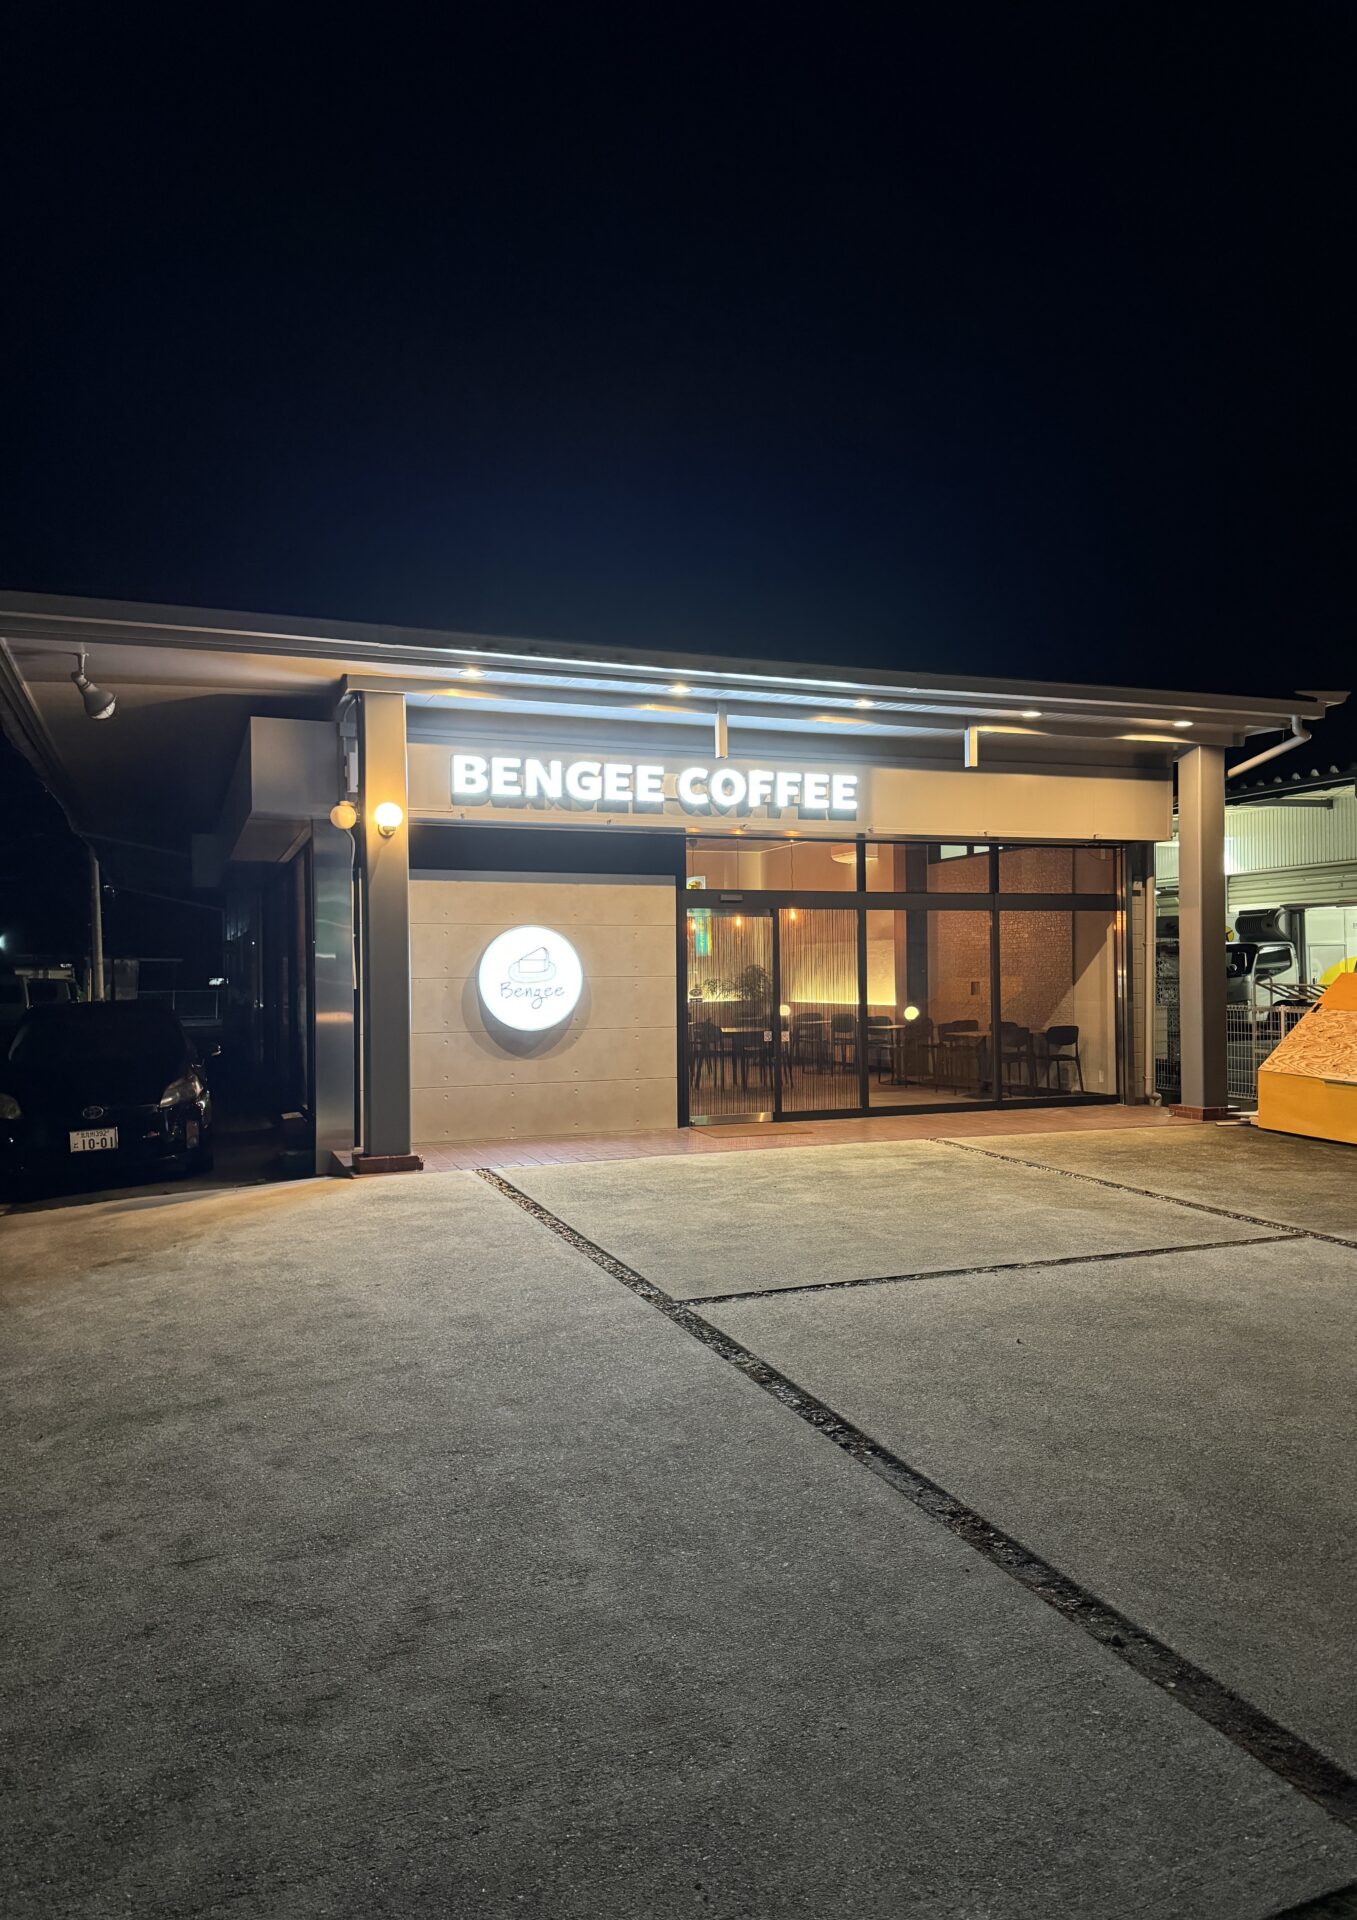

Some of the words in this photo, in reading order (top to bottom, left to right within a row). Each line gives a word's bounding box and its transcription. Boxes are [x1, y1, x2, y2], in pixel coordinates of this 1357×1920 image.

[452, 754, 664, 802] BENGEE
[678, 766, 858, 810] COFFEE
[500, 981, 565, 1010] Bengee
[82, 1136, 113, 1150] 10-01
